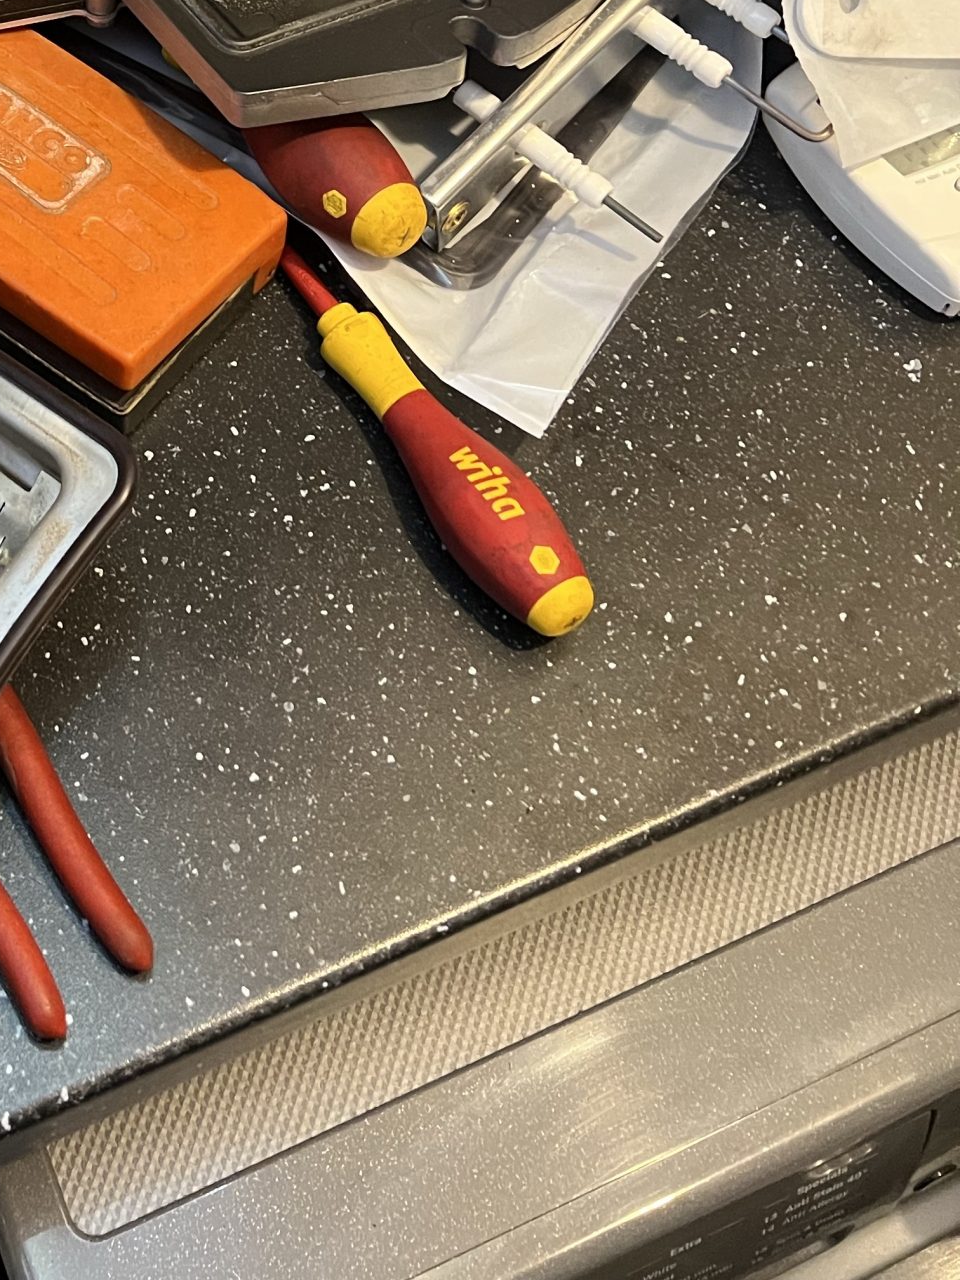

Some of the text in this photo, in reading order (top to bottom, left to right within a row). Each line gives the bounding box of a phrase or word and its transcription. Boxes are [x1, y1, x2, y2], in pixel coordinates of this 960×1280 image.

[448, 446, 526, 521] wiha
[796, 1167, 848, 1196] Specials
[784, 1196, 810, 1214] Anti
[668, 1234, 703, 1257] Extra
